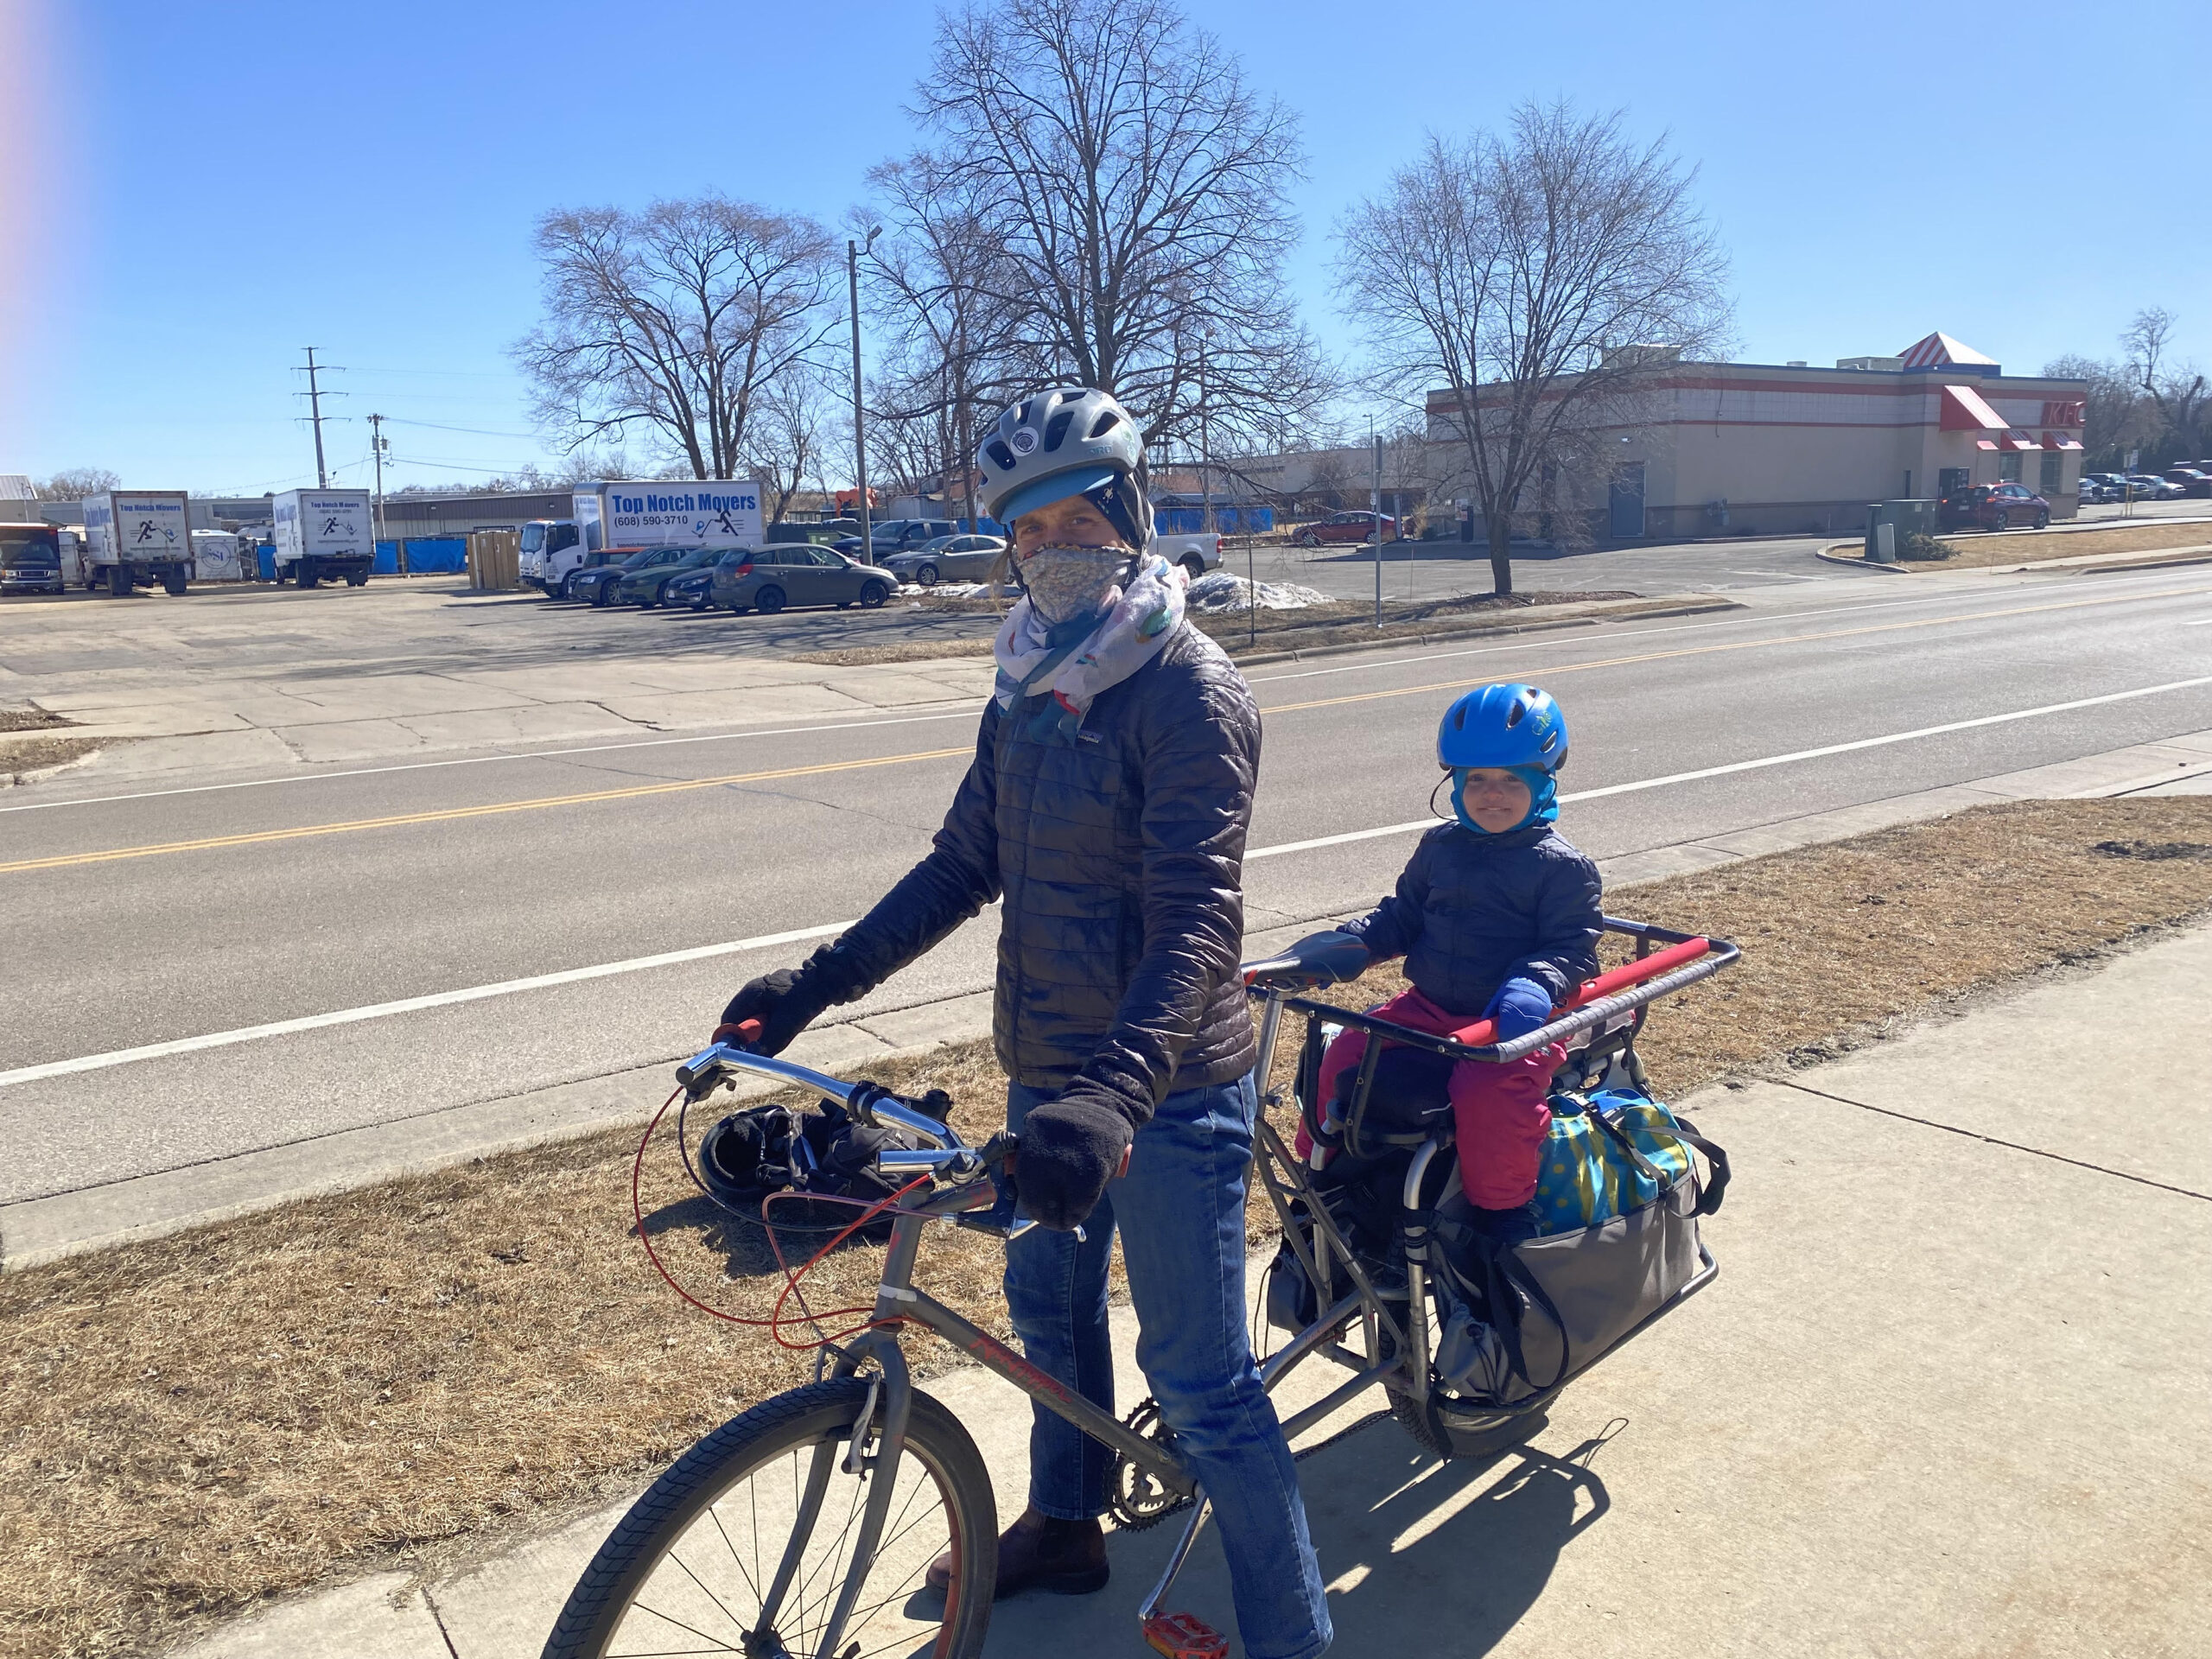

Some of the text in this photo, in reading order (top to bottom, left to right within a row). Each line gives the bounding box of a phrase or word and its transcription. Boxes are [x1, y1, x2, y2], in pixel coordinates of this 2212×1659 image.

[2047, 401, 2087, 425] KFC
[612, 495, 644, 514] Top
[647, 494, 695, 512] Notch
[698, 493, 756, 512] Movers
[614, 515, 689, 528] (608) 590-3710
